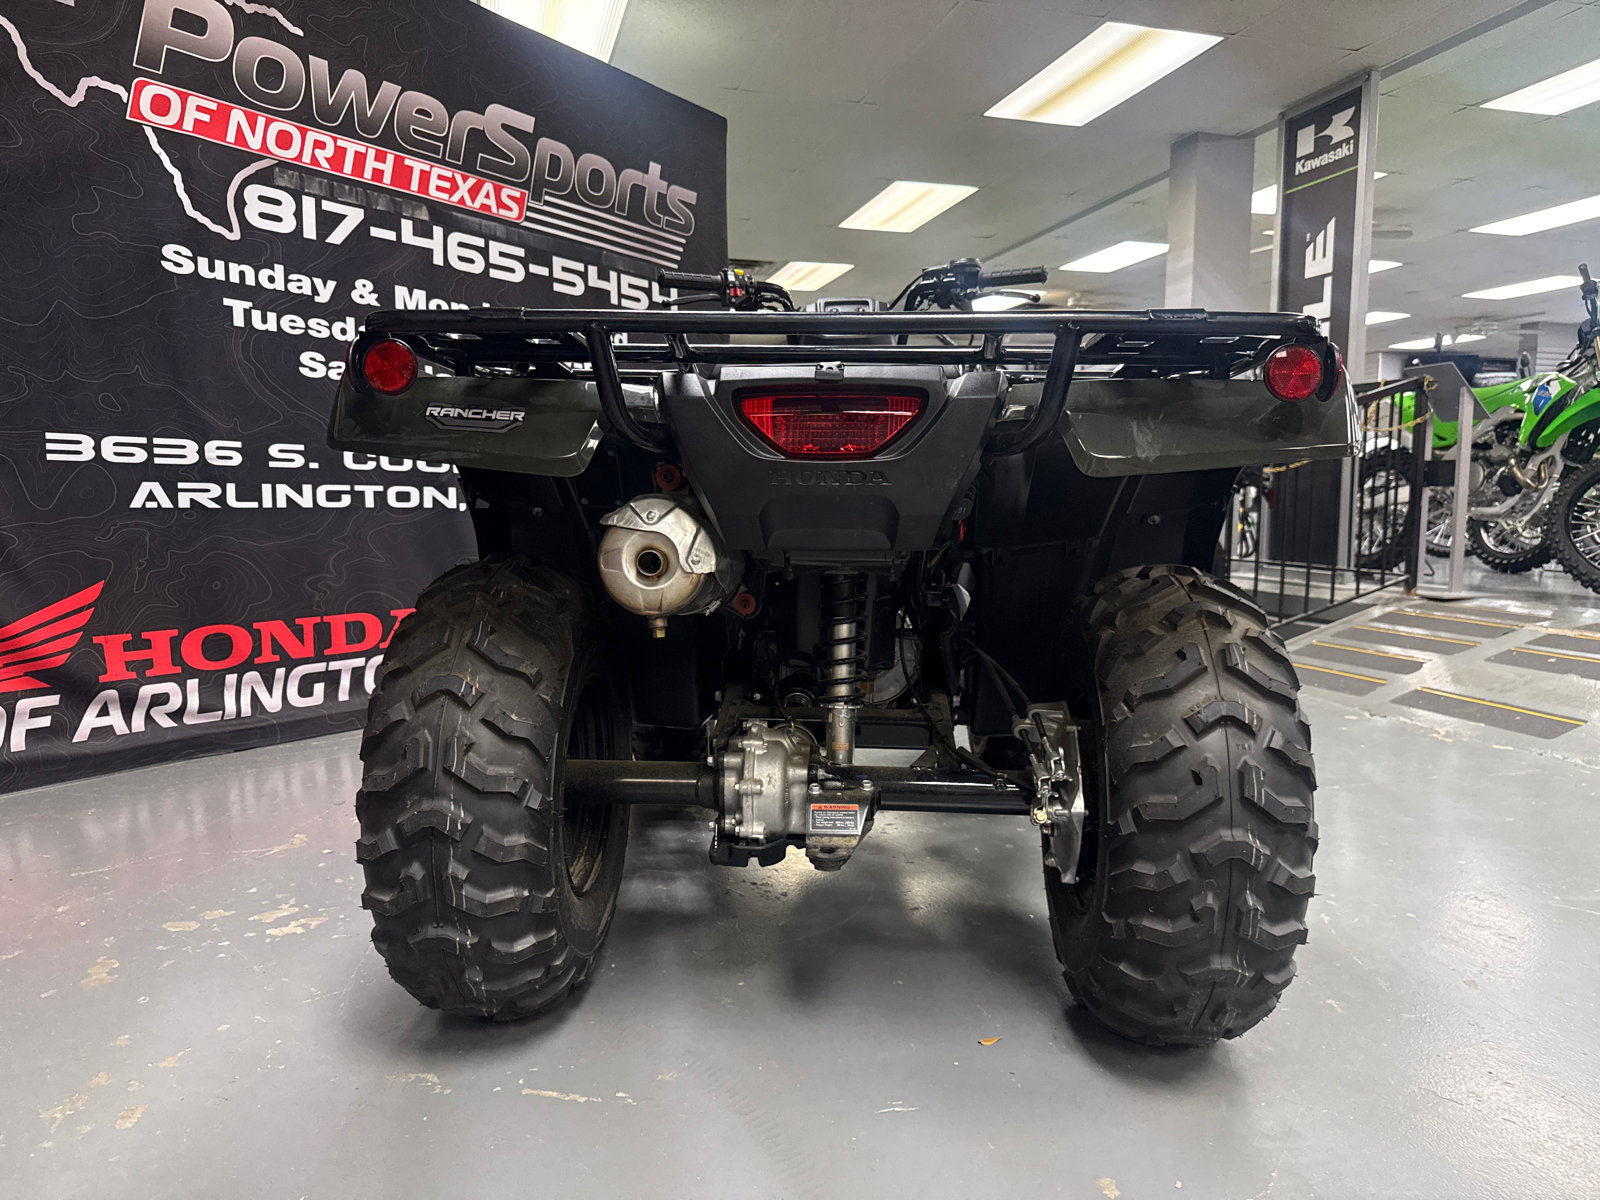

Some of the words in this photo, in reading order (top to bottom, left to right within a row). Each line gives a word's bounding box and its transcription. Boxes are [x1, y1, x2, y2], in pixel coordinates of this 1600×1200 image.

[132, 0, 698, 237] PowerSports
[139, 83, 218, 132] OF
[225, 108, 395, 186] NORTH
[403, 157, 521, 219] TEXAS
[1295, 140, 1355, 176] Kawasaki
[243, 184, 679, 311] 817-465-5454
[160, 243, 337, 303] Sunday
[350, 278, 381, 307] &
[425, 406, 526, 421] RANCHER
[44, 431, 243, 467] 3636
[267, 443, 320, 469] S.
[128, 481, 468, 512] ARLINGTON,
[768, 469, 893, 486] HONDA
[0, 694, 61, 753] F
